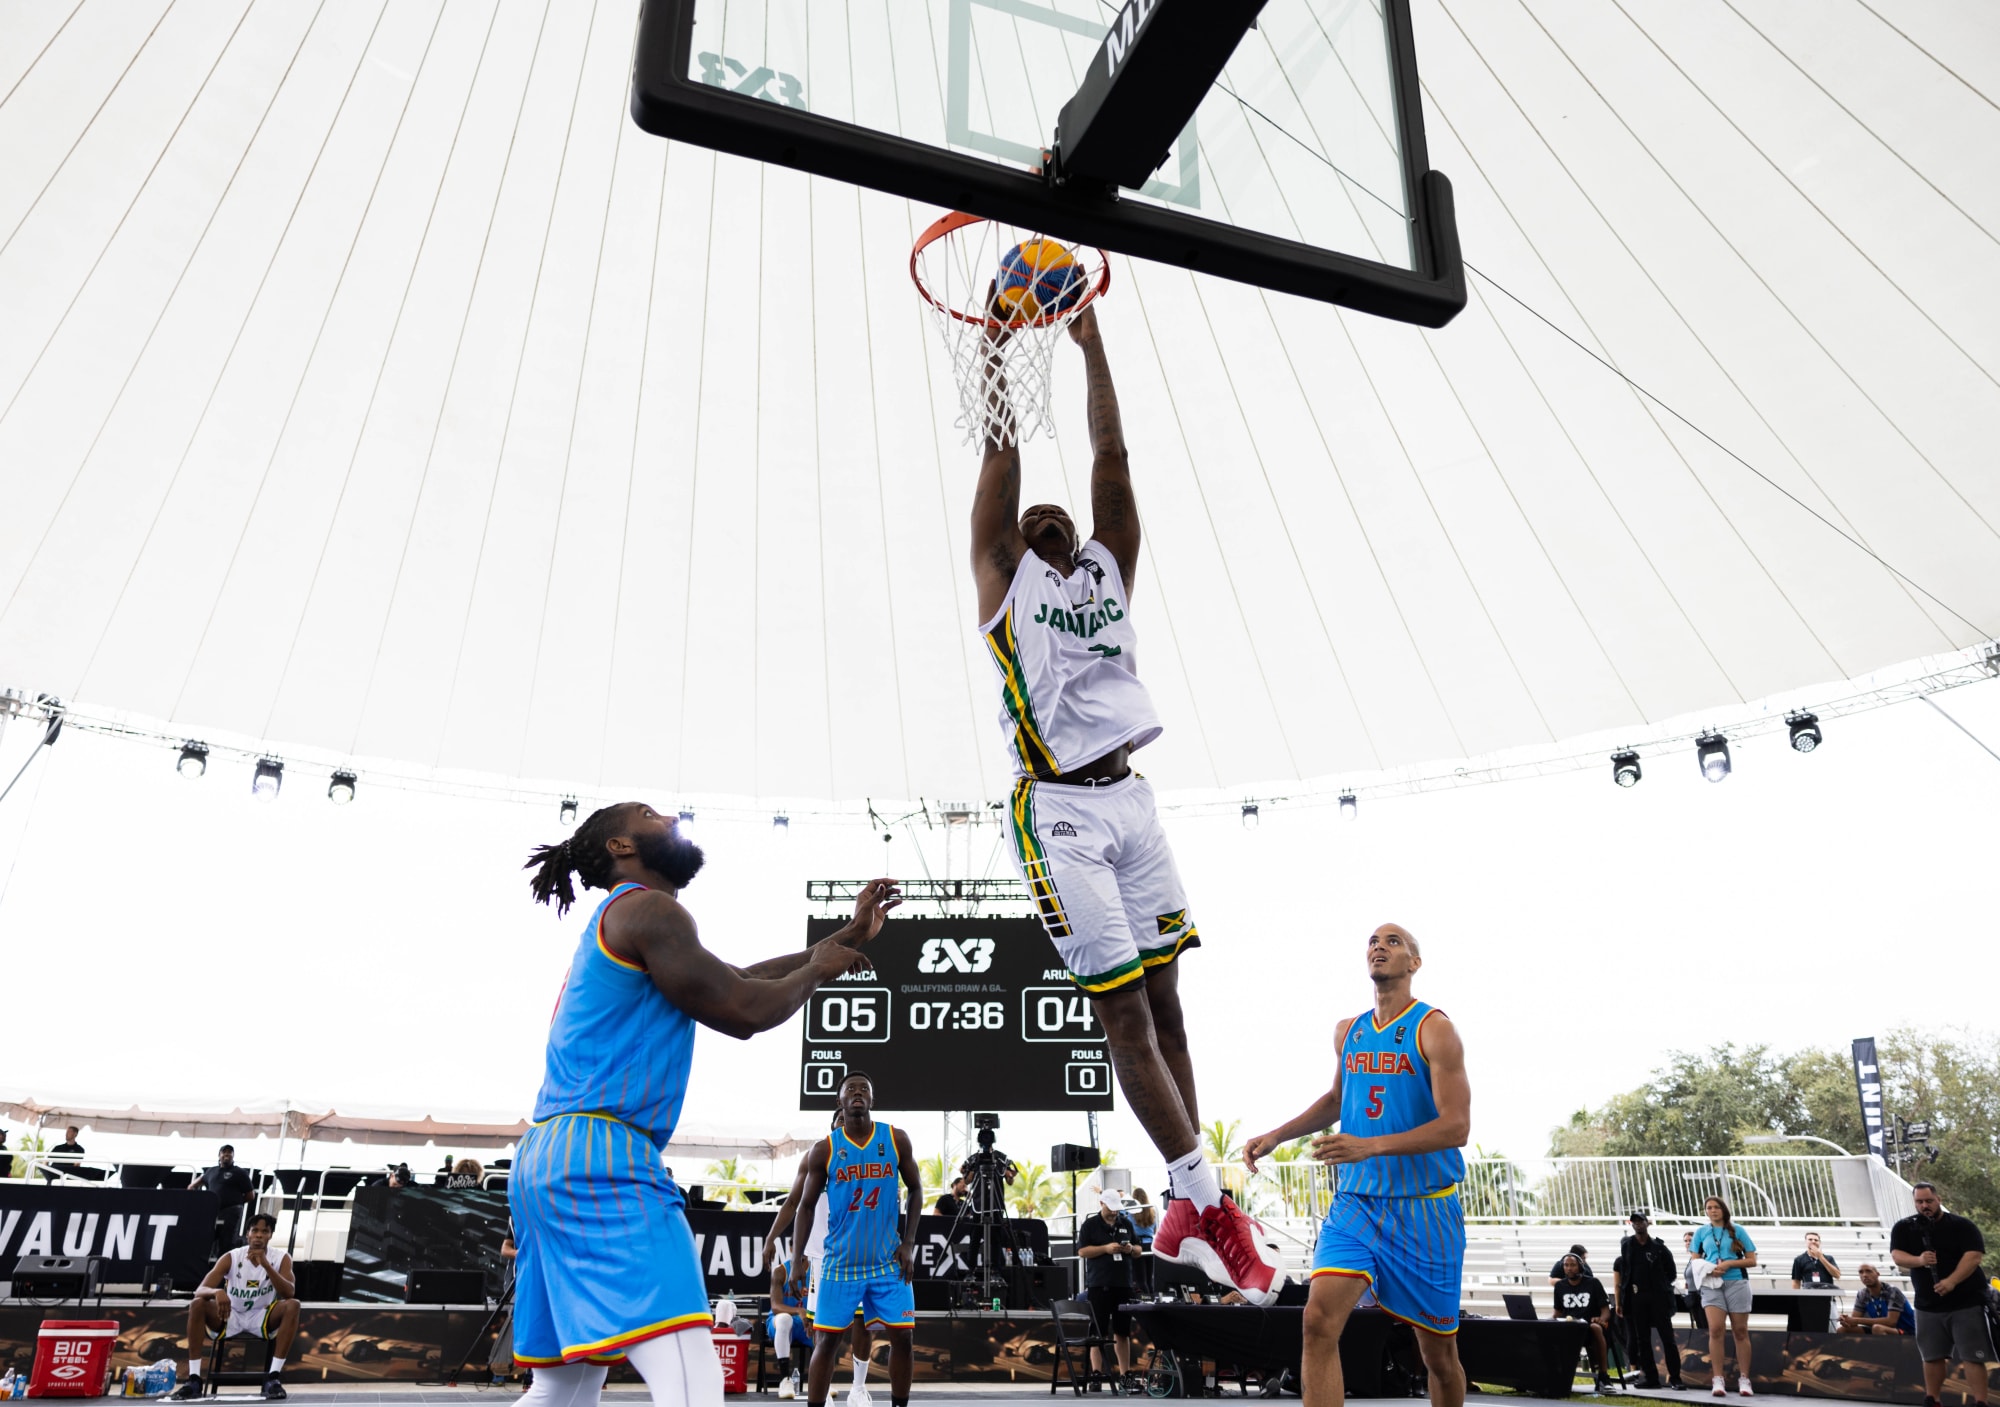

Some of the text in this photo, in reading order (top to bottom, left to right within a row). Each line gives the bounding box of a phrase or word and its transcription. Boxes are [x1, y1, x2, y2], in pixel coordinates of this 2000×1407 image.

[834, 970, 878, 981] MAICA
[901, 984, 953, 993] QUALIFYING
[955, 984, 980, 992] DRAW
[981, 984, 988, 992] A
[822, 997, 876, 1031] 05
[910, 1002, 1004, 1029] 07:36
[1038, 997, 1094, 1031] 04
[811, 1050, 842, 1060] FOULS
[1071, 1050, 1103, 1060] FOULS
[1345, 1051, 1416, 1075] ARUBA
[817, 1068, 834, 1089] 0
[1079, 1068, 1096, 1089] 0
[1365, 1085, 1386, 1120] 5
[835, 1162, 895, 1183] ARUBA
[848, 1186, 881, 1212] 24
[230, 1284, 274, 1299] JAMAICA
[1418, 1311, 1455, 1325] ARUBA
[54, 1341, 92, 1356] BIO
[52, 1356, 89, 1364] STEEL
